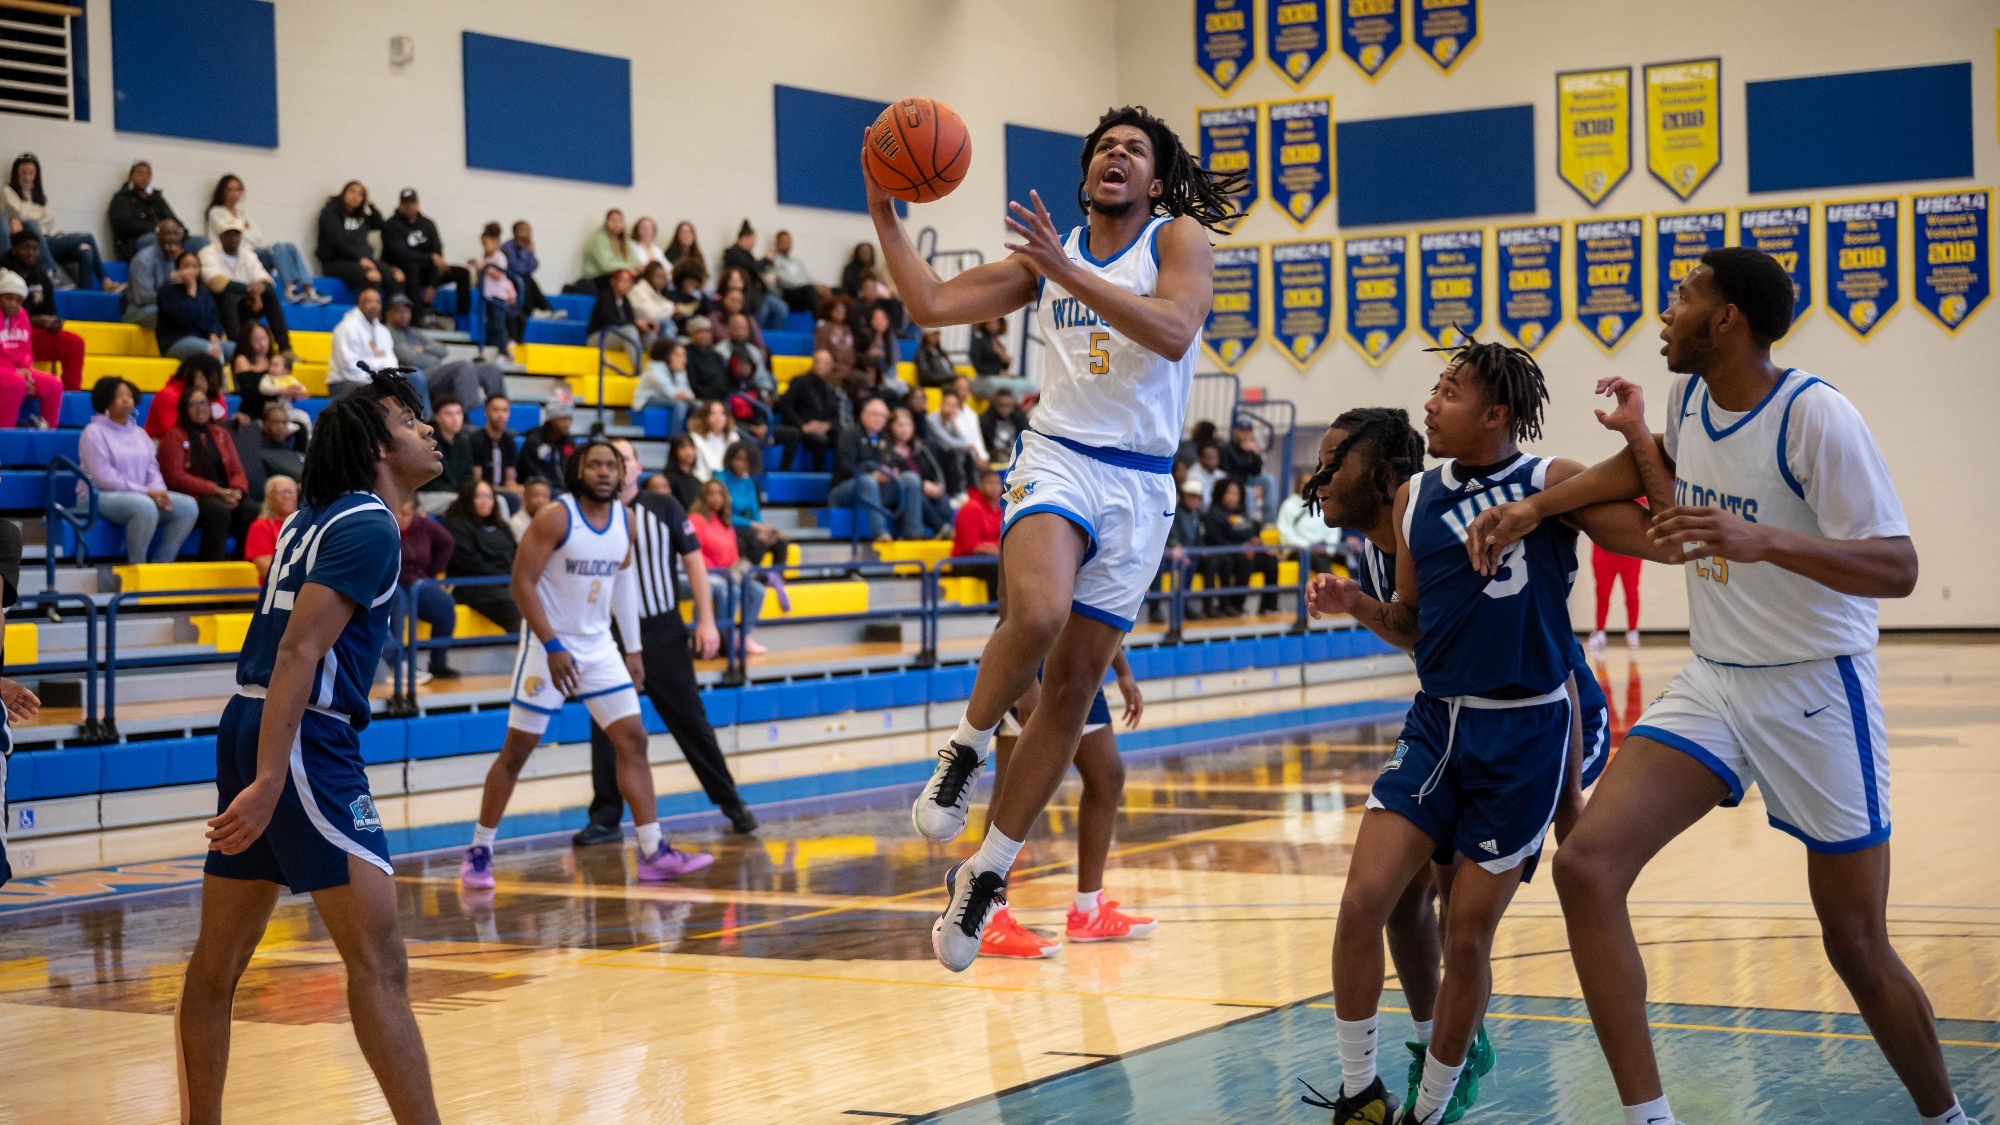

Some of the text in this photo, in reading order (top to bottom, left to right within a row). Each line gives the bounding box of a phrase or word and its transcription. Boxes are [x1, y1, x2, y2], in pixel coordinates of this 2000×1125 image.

[875, 126, 900, 160] THE
[1926, 212, 1976, 226] Women's
[1925, 224, 1978, 240] Volleyball
[1928, 240, 1976, 265] 2019
[1587, 263, 1631, 286] 2017
[1089, 333, 1110, 375] 5
[262, 525, 318, 615] 12
[1482, 538, 1529, 599] 3
[587, 579, 601, 604] 2
